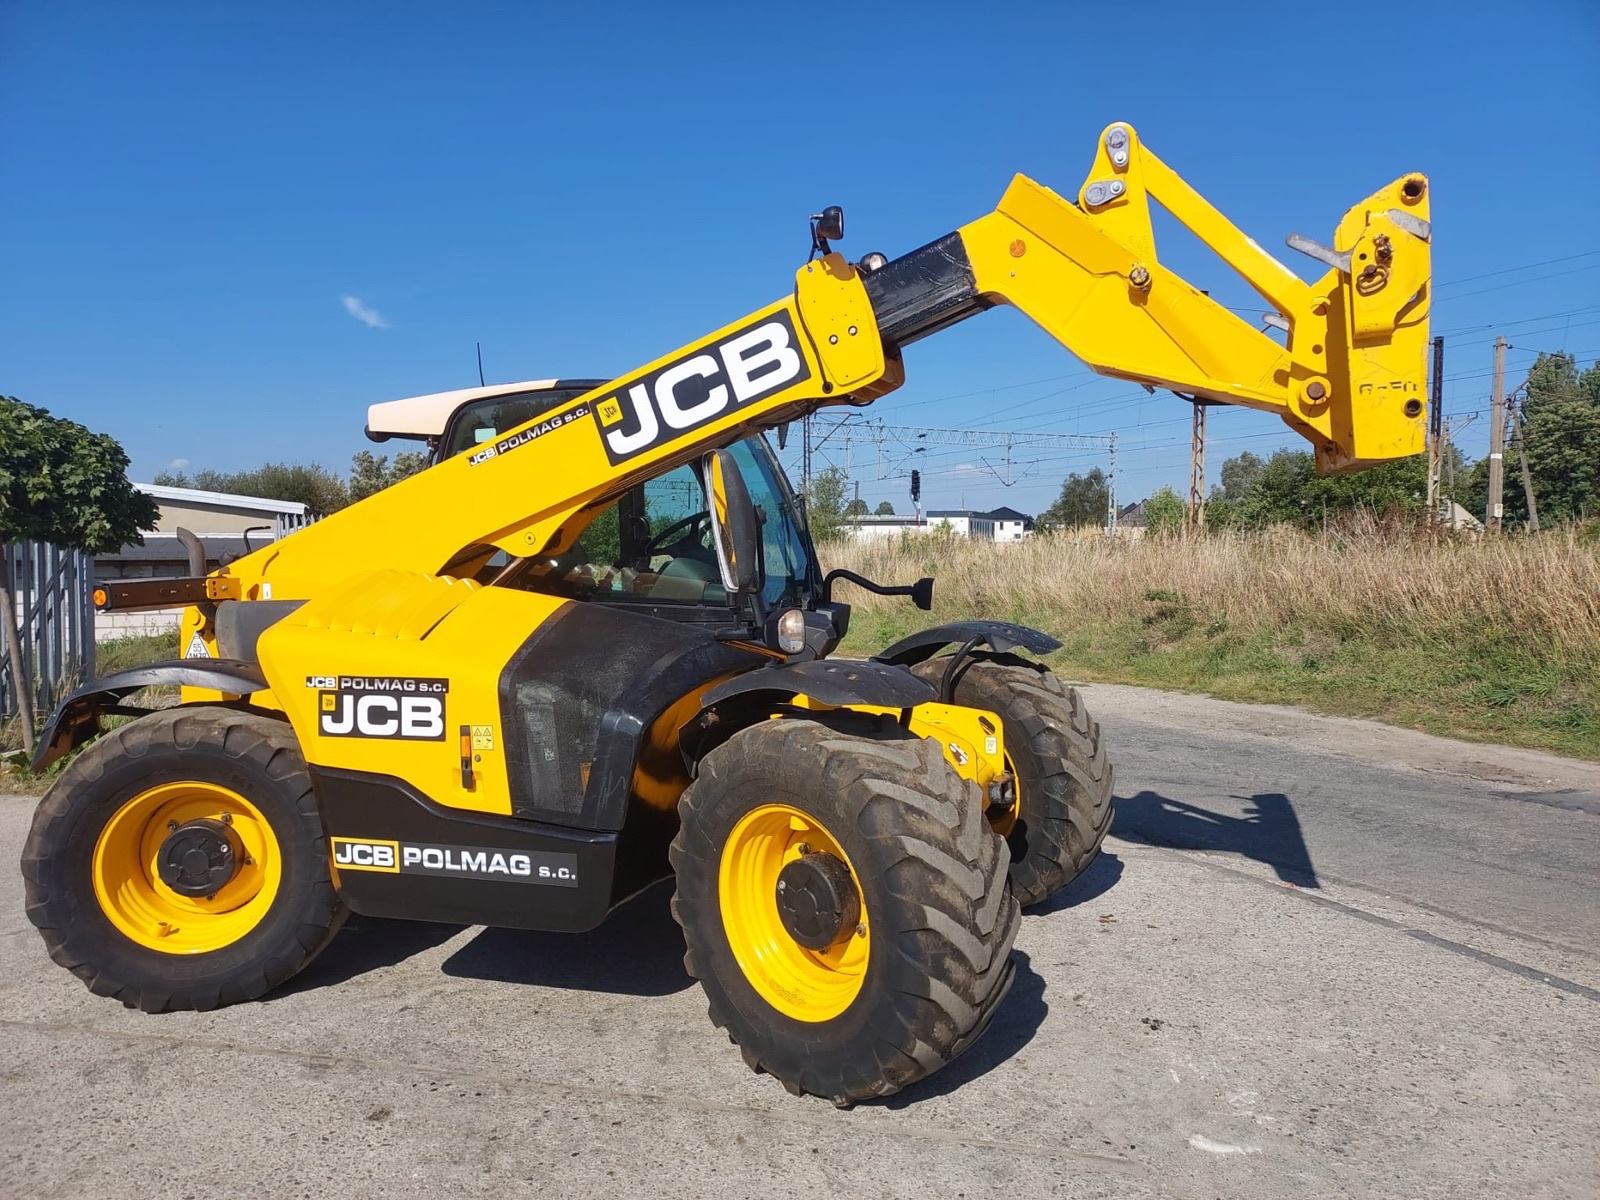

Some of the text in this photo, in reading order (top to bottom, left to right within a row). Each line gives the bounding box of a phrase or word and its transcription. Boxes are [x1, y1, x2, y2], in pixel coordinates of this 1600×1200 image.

[606, 321, 801, 455] JCB
[470, 407, 588, 466] JCB POLMAG s.c.
[306, 676, 446, 692] JCB POLMAG s.c.
[322, 694, 444, 737] JCB
[335, 843, 577, 880] JCB POLMAG s.c.
